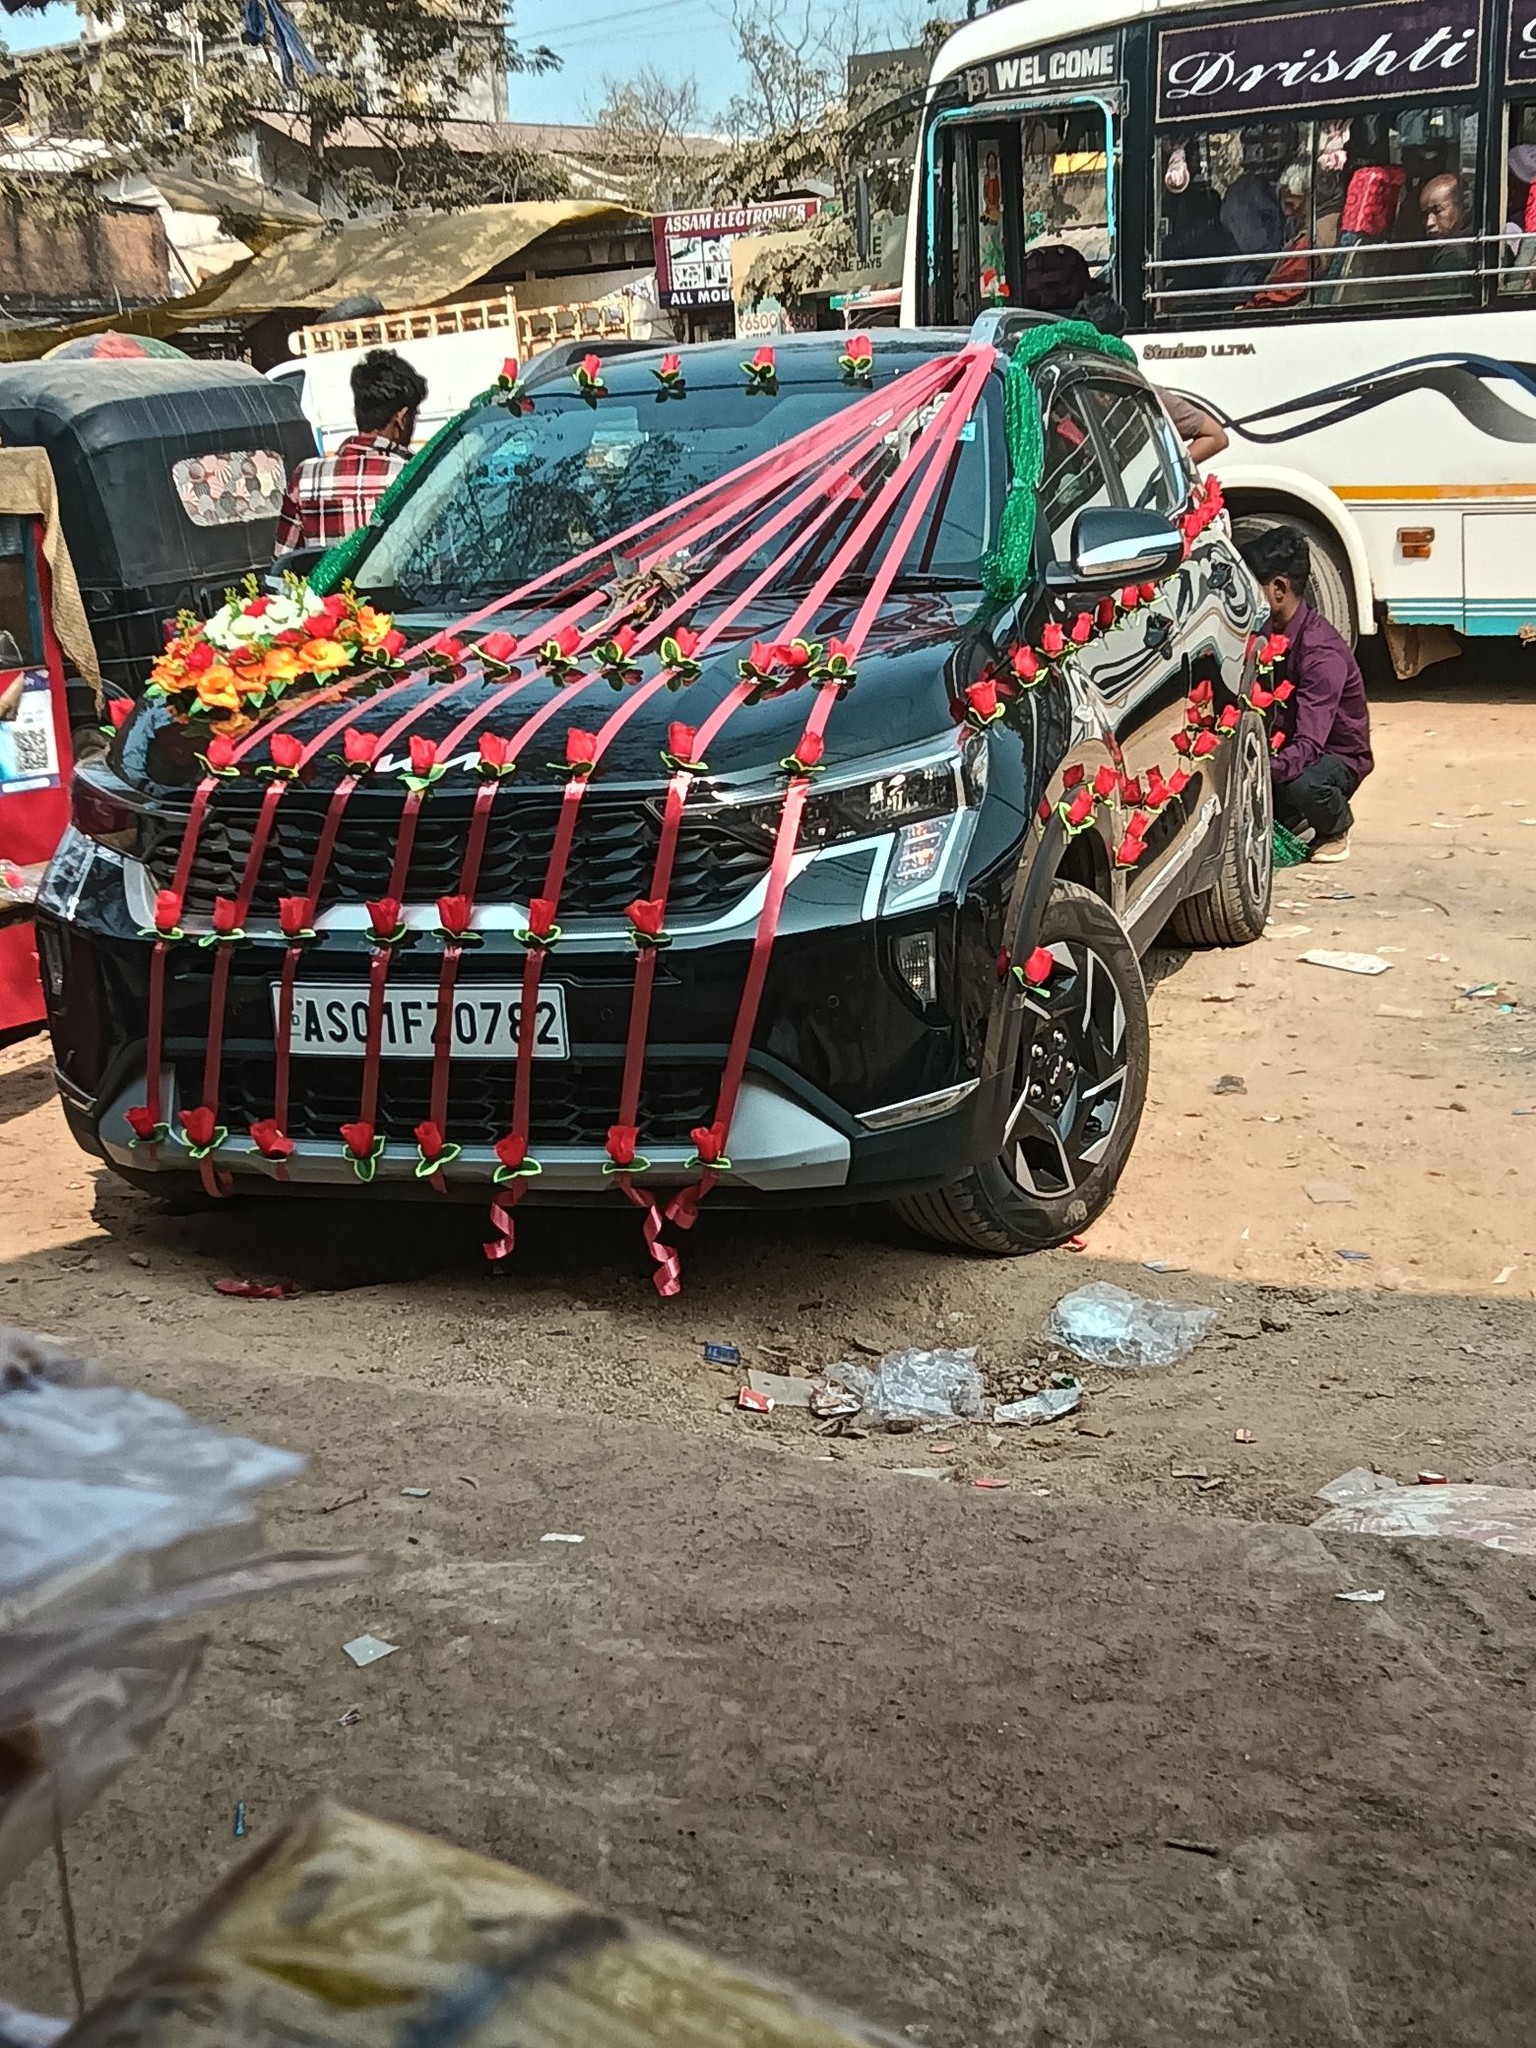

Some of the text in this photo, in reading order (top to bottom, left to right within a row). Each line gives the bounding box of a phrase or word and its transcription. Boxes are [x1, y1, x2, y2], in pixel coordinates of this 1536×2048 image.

[1166, 26, 1475, 99] Drishti
[664, 214, 710, 233] ASSAM
[670, 291, 693, 305] ALL
[1143, 342, 1256, 360] Starbus ULTRA
